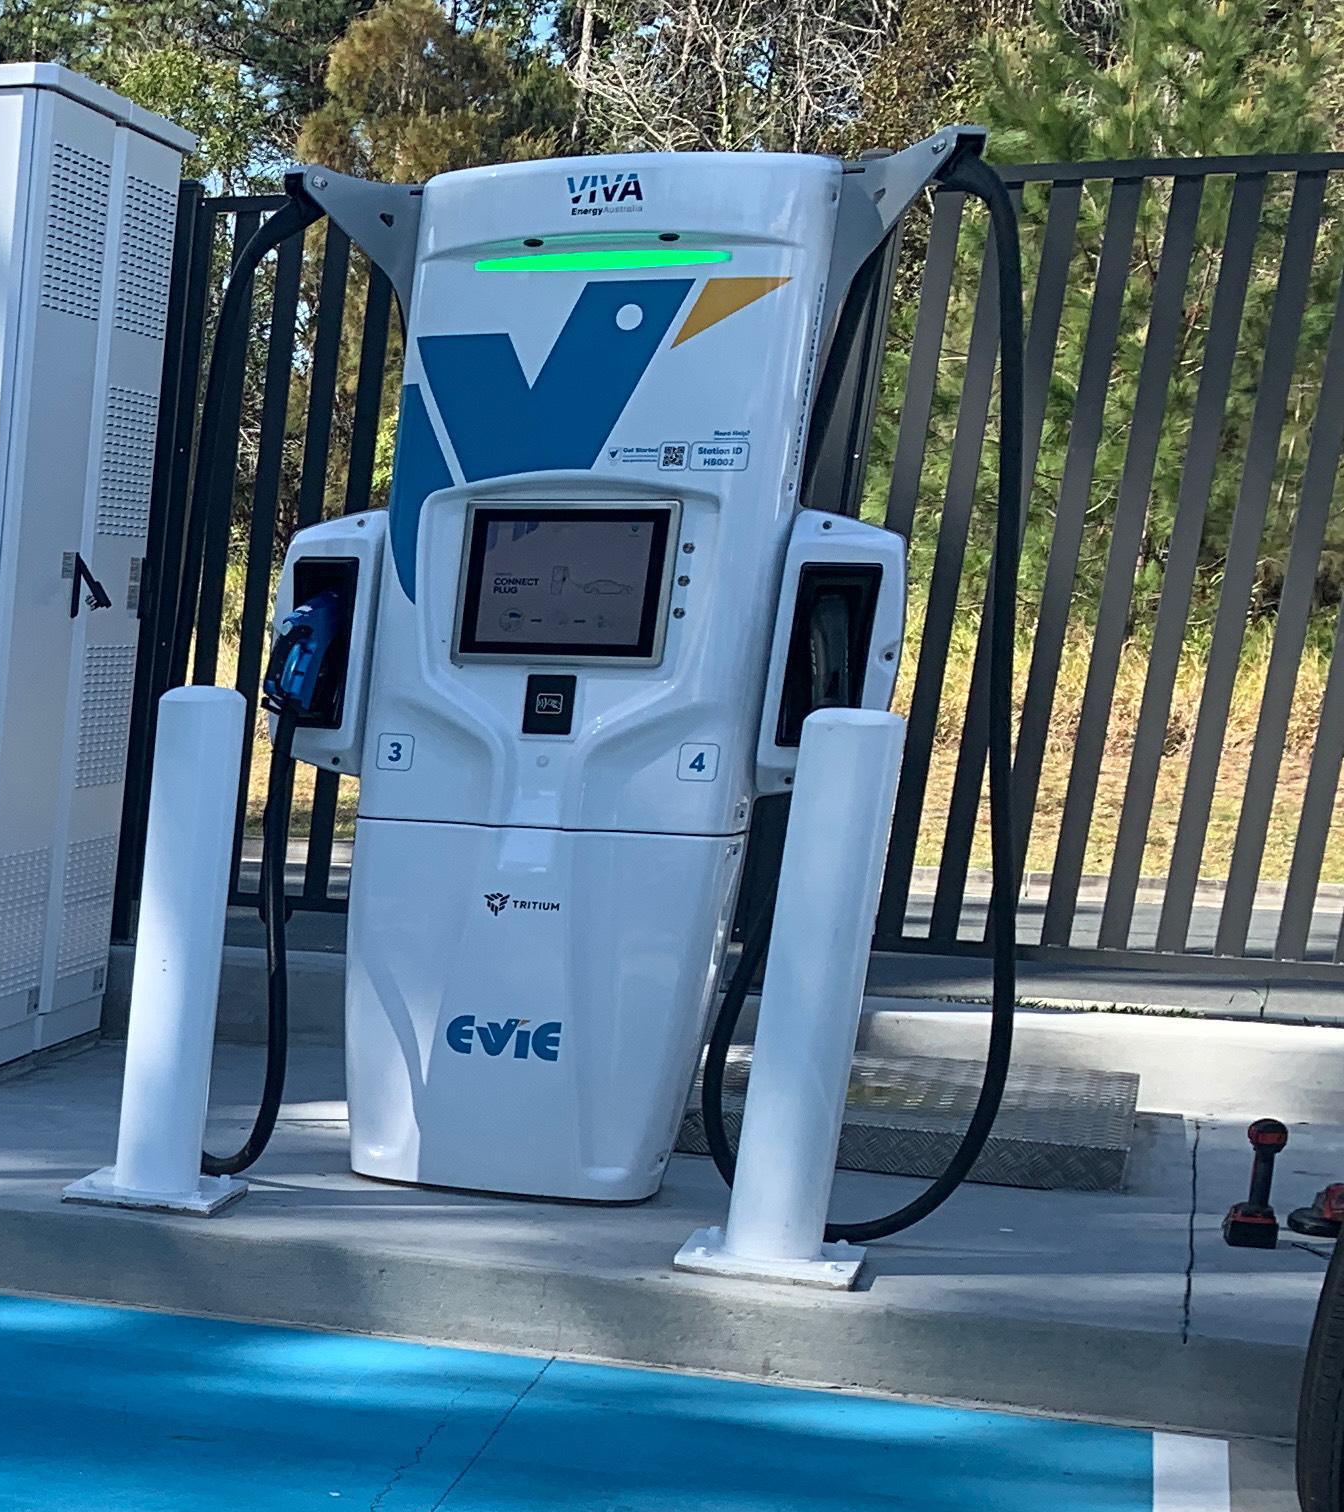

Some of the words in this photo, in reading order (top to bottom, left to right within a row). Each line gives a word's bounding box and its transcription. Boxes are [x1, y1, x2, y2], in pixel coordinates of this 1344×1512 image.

[567, 173, 643, 204] VIVA
[698, 447, 730, 455] Station
[732, 447, 743, 455] ID
[494, 577, 540, 586] CONNECT
[493, 586, 518, 594] PLUG
[388, 742, 402, 762] 3
[689, 752, 705, 773] 4
[512, 900, 560, 911] TRITIUM
